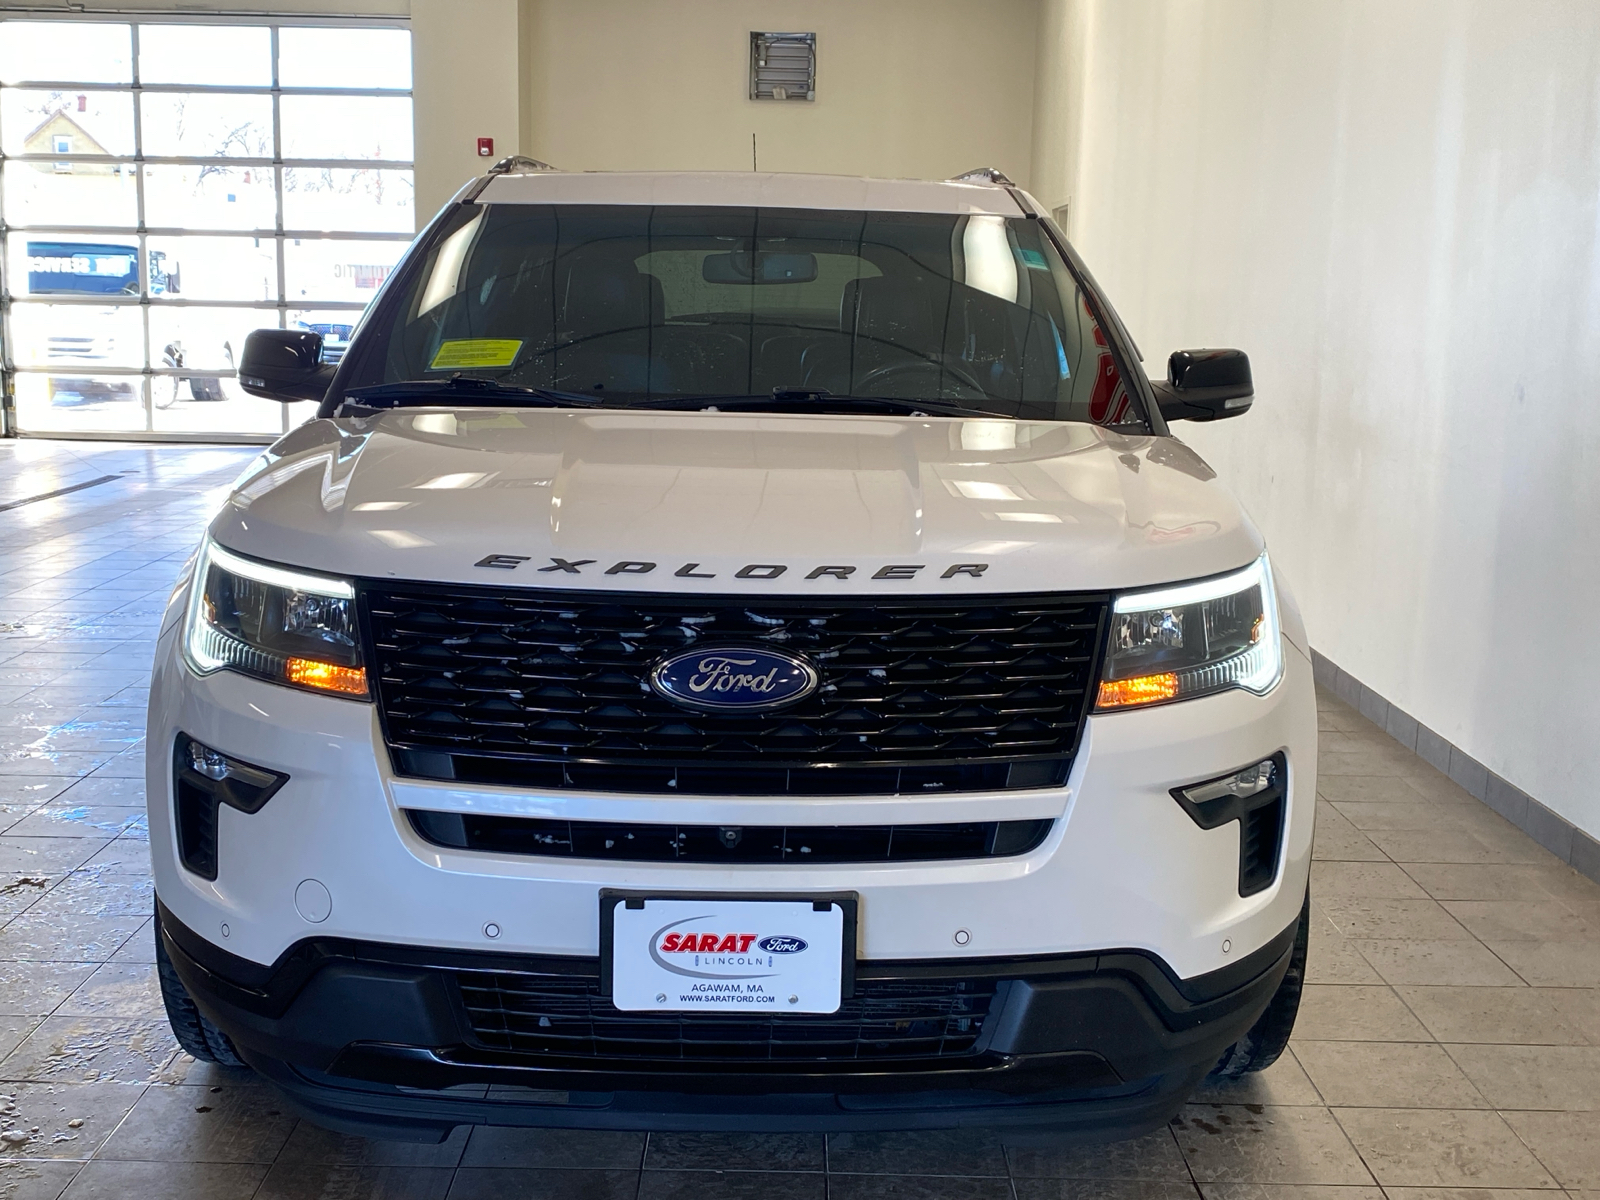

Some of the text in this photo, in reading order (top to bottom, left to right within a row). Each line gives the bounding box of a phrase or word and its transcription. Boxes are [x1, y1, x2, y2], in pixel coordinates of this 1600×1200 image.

[474, 553, 989, 580] EXPLORER
[688, 656, 779, 695] Ford
[660, 932, 758, 954] SARAT
[704, 957, 763, 966] LINCOLN
[691, 983, 764, 994] AGAWAM, MA
[679, 994, 775, 1004] WWW.SARATFORD.COM
